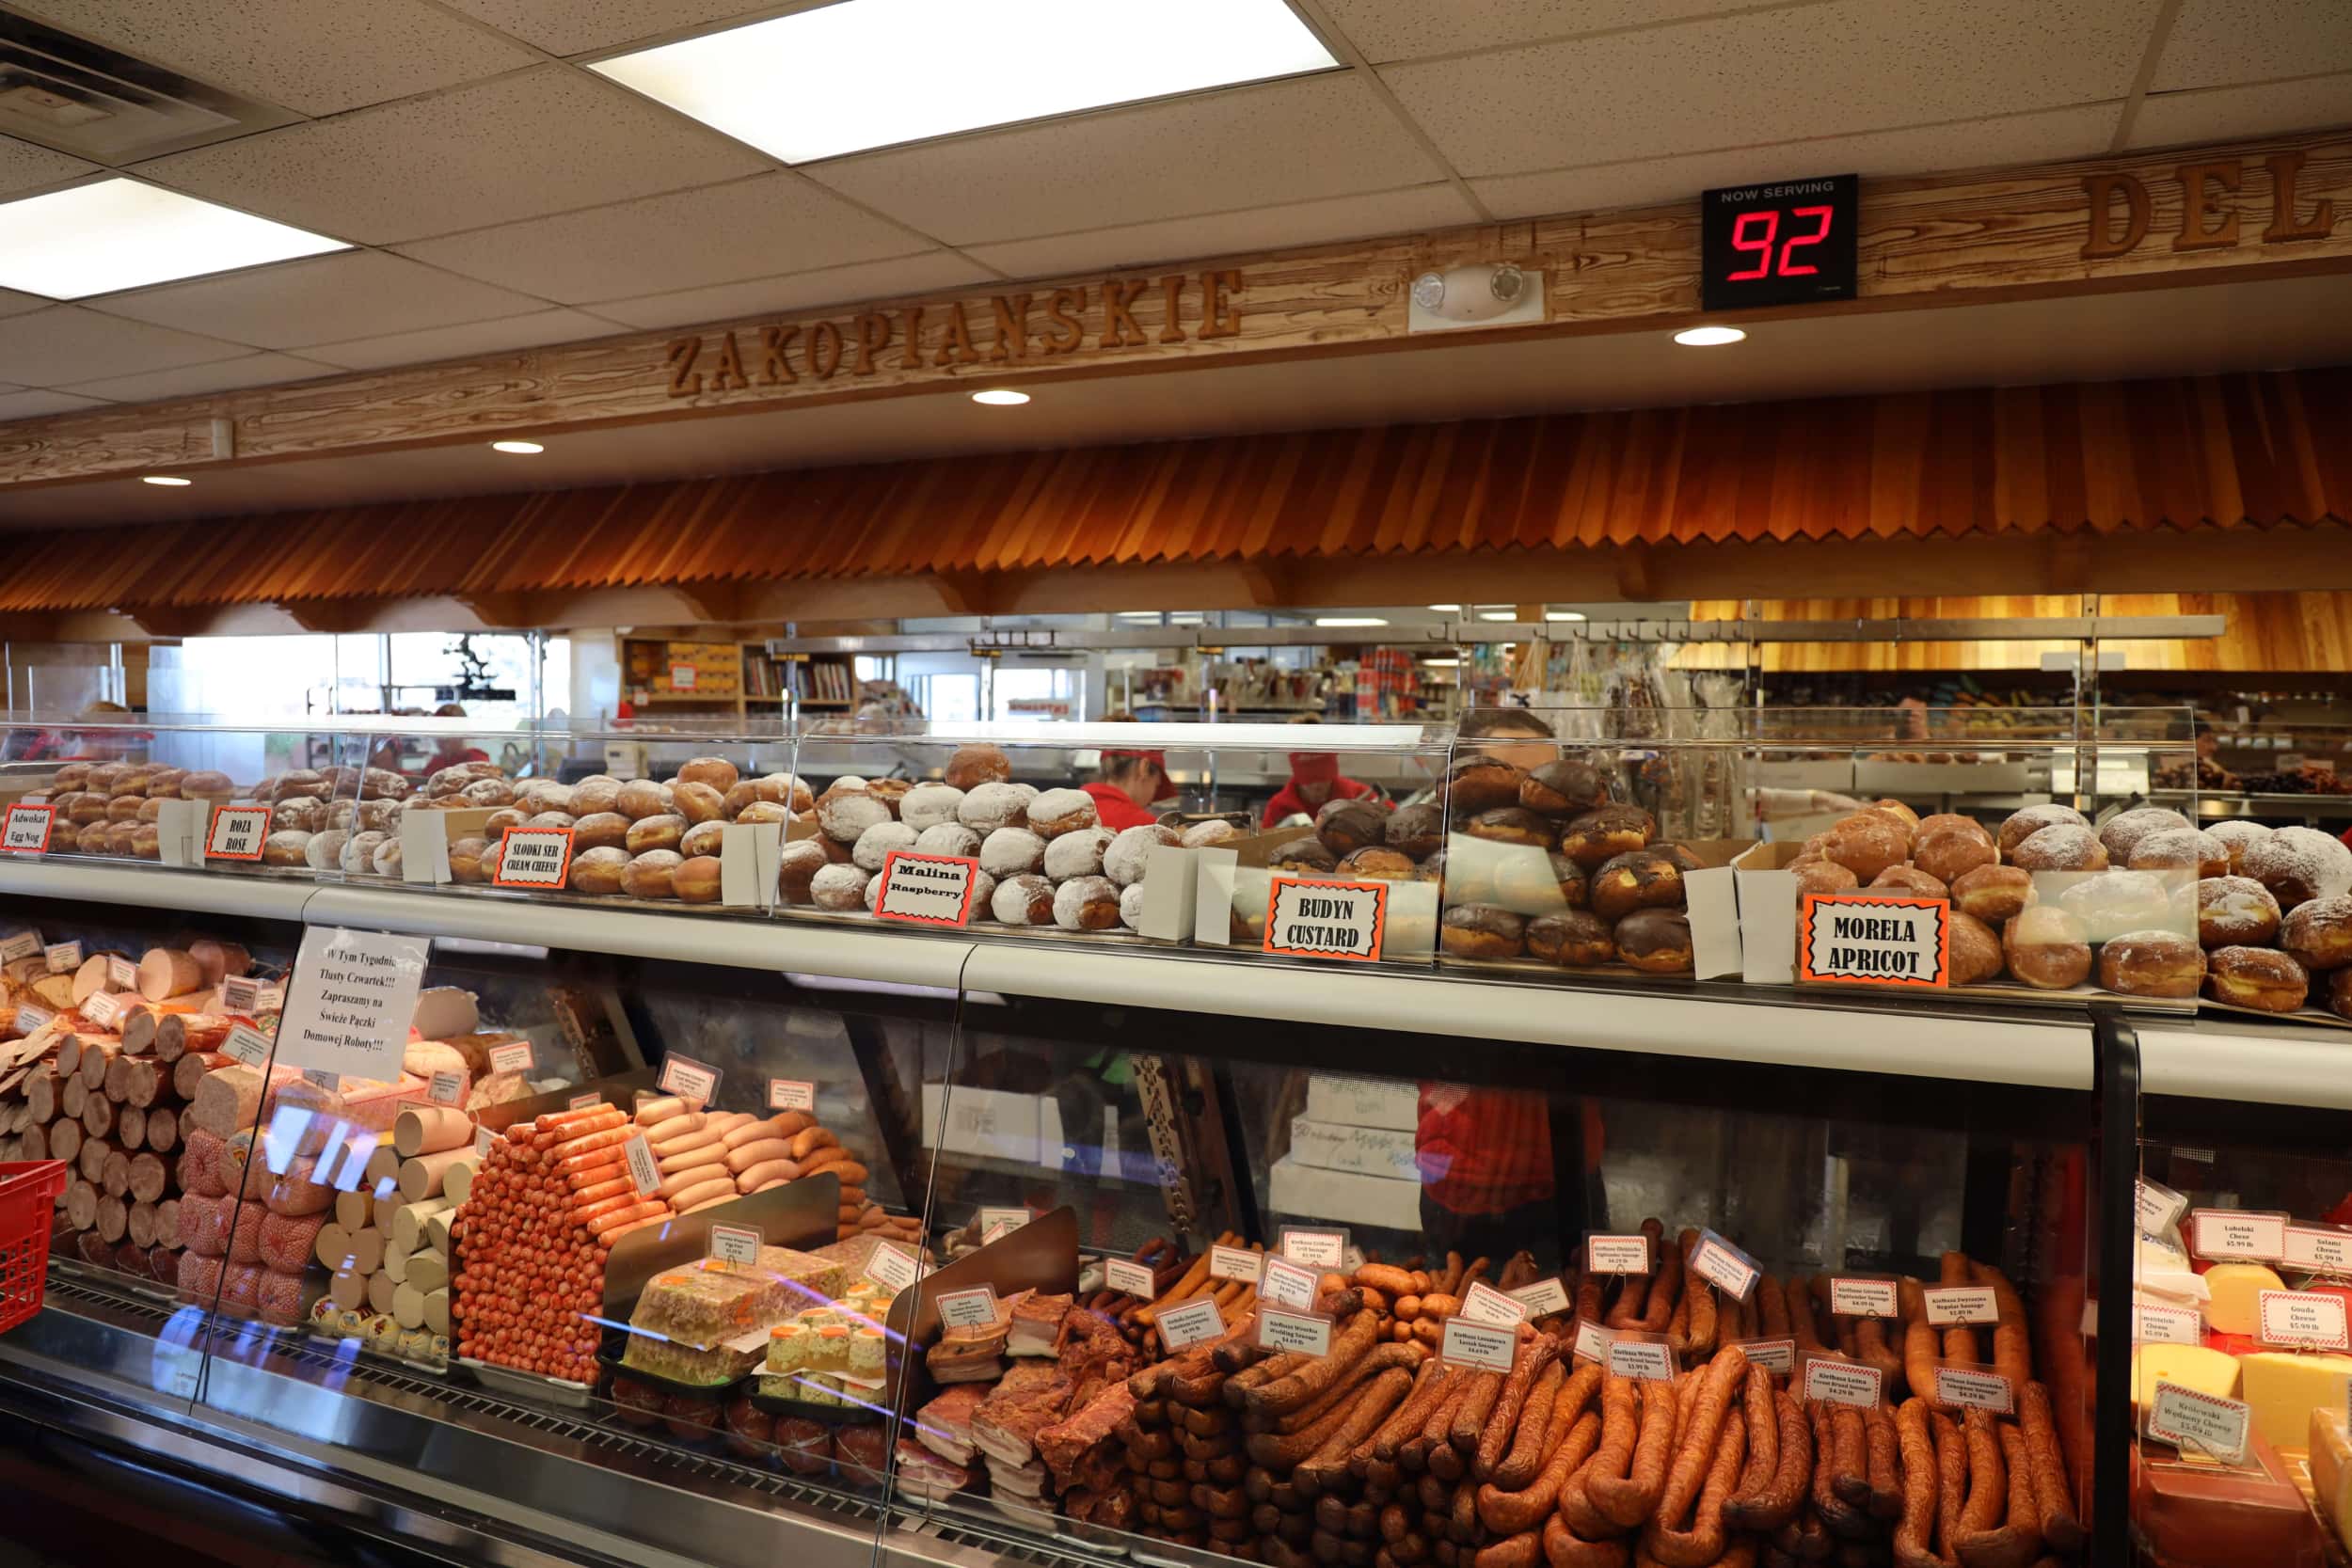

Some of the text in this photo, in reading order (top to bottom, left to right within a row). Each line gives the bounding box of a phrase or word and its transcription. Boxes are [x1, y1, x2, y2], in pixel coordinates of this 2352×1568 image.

[1721, 181, 1835, 203] NOW SERVING
[2078, 151, 2333, 261] DEL
[1726, 205, 1834, 281] 92
[666, 269, 1242, 398] ZAKOPIANSKIE
[12, 813, 46, 823] Adwokat
[229, 819, 251, 833] ROZA
[10, 832, 40, 844] Egg Nog
[225, 838, 247, 851] ROSE
[542, 845, 559, 858] SER
[506, 859, 558, 873] CREAM CHEESE
[898, 864, 961, 880] Malina
[890, 883, 961, 899] Raspberry
[1298, 897, 1354, 920] BUDYN
[1287, 925, 1359, 947] CUSTARD
[1834, 916, 1915, 942] MORELA
[327, 948, 338, 958] W
[339, 950, 358, 963] Tym
[1828, 947, 1919, 974] APRICOT
[347, 972, 396, 989] Czwartek!!!
[321, 989, 383, 1008] Zapraszamy na
[303, 1029, 384, 1052] Domowej Roboty!!!
[2316, 1238, 2342, 1247] Salami
[2316, 1246, 2342, 1255] Cheese
[2290, 1306, 2314, 1314] Gouda
[2290, 1313, 2316, 1322] Cheese
[2203, 1418, 2232, 1433] Cheese
